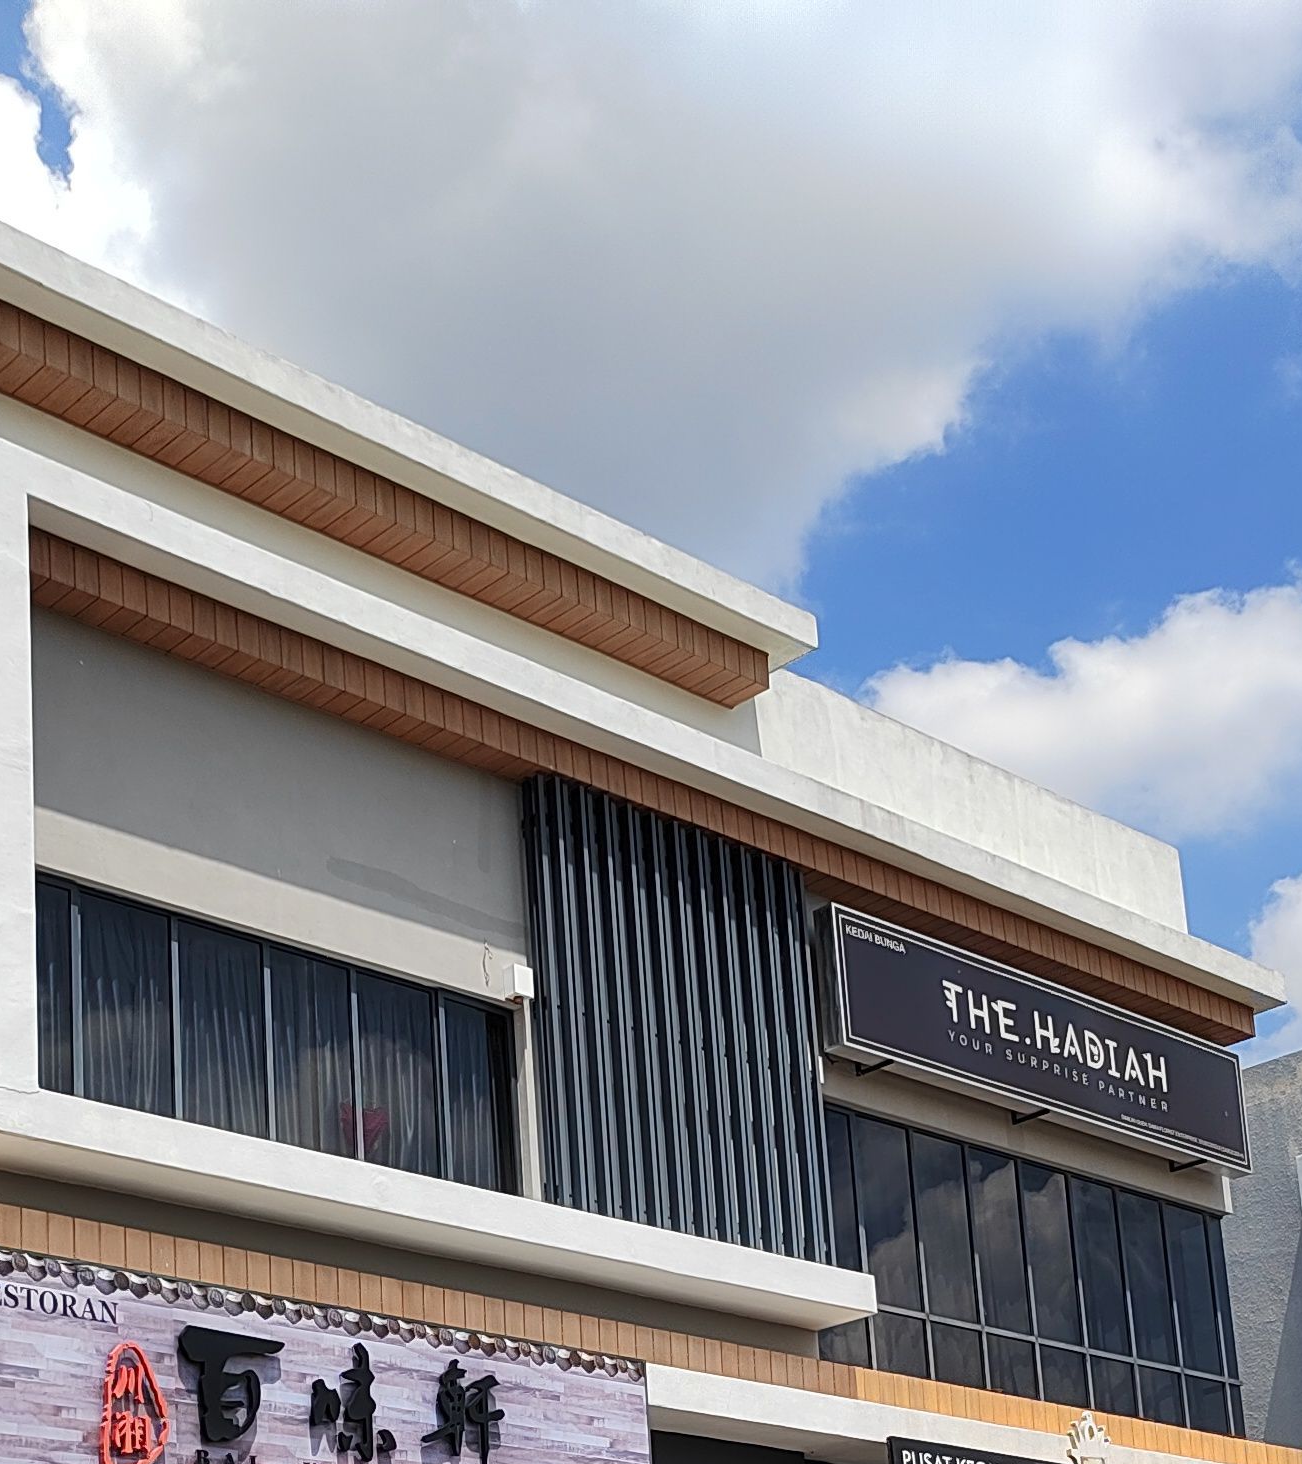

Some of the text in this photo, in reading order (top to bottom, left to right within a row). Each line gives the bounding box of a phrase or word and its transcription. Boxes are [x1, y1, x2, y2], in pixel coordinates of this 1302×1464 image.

[874, 933, 906, 955] BUNGA
[948, 1029, 1169, 1113] YOUR SURPRISE PARTNER
